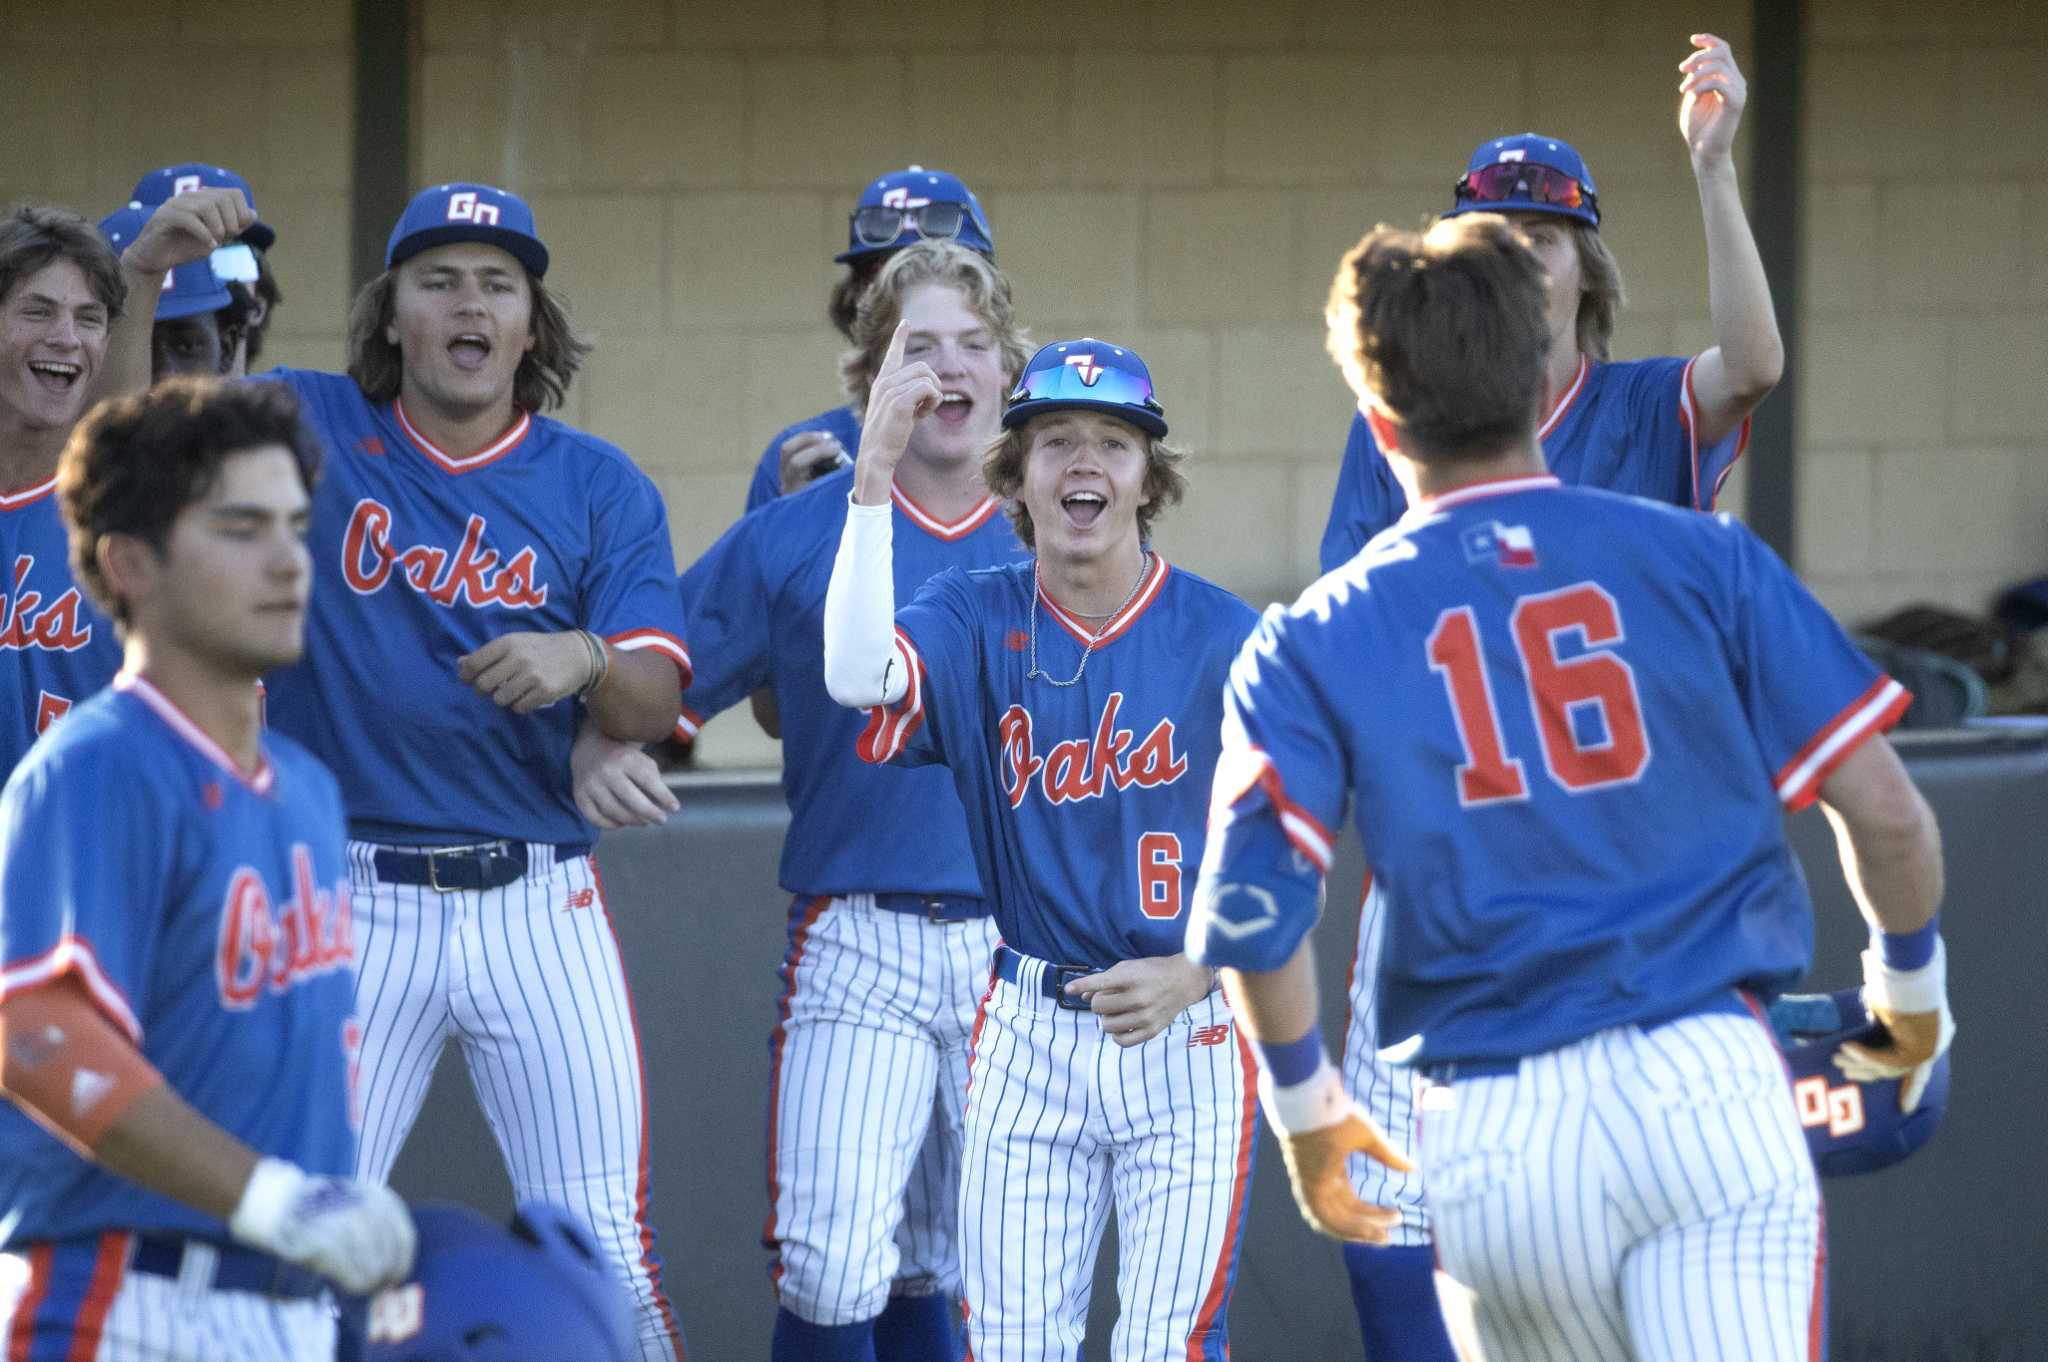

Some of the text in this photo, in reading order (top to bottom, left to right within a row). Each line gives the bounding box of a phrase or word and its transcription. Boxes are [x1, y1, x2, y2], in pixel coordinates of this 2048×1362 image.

[341, 498, 549, 610] Oaks
[999, 692, 1188, 810] Oaks
[1425, 580, 1652, 808] 16
[1138, 831, 1182, 920] 6
